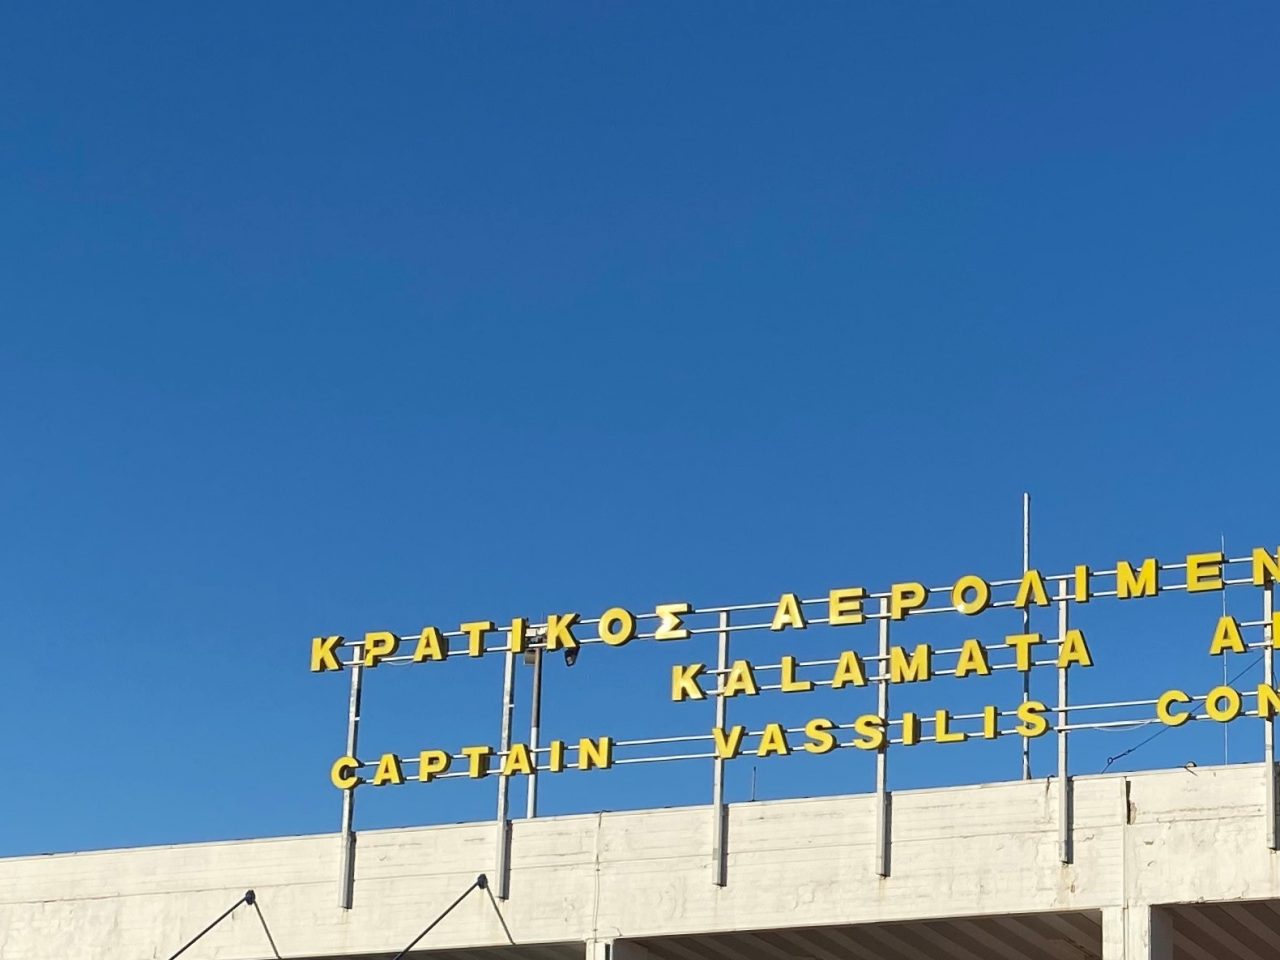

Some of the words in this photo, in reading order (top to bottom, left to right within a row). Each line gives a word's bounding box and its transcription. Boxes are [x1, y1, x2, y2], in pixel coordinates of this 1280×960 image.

[311, 603, 692, 673] ΚΡΑΤΙΚΟΣ
[672, 629, 1093, 702] KALAMATA
[330, 736, 614, 791] CAPTAIN
[713, 700, 1051, 760] VASSILIS
